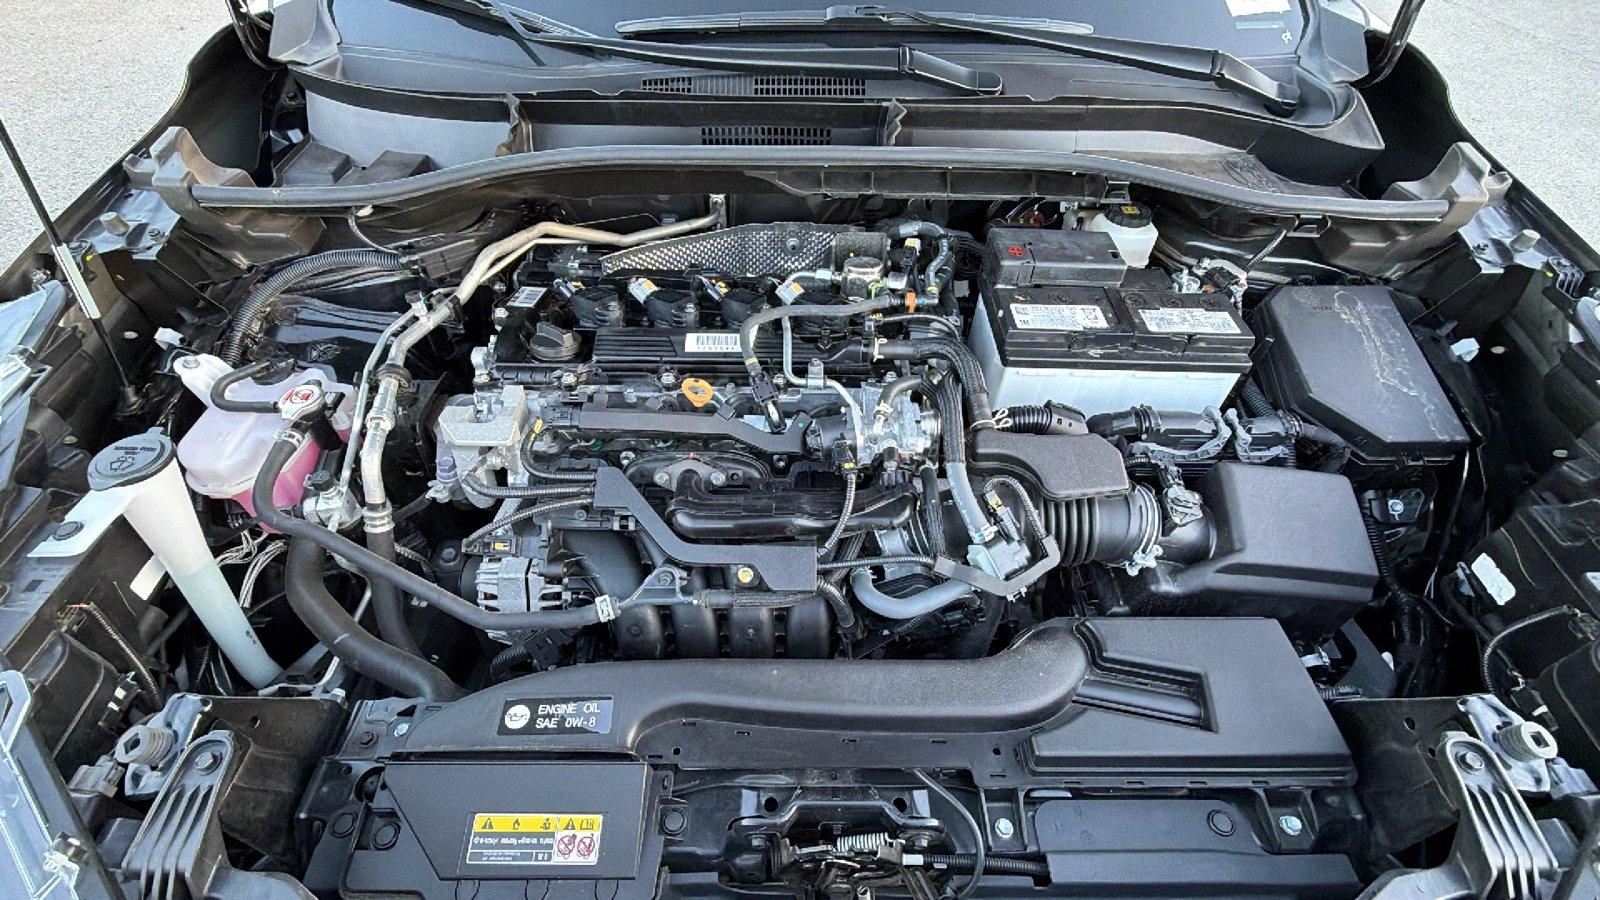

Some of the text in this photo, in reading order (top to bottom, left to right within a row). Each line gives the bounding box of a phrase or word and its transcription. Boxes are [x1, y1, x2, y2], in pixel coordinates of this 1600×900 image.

[538, 703, 600, 714] ENGINE OIL
[535, 717, 596, 728] SAE 0W-8
